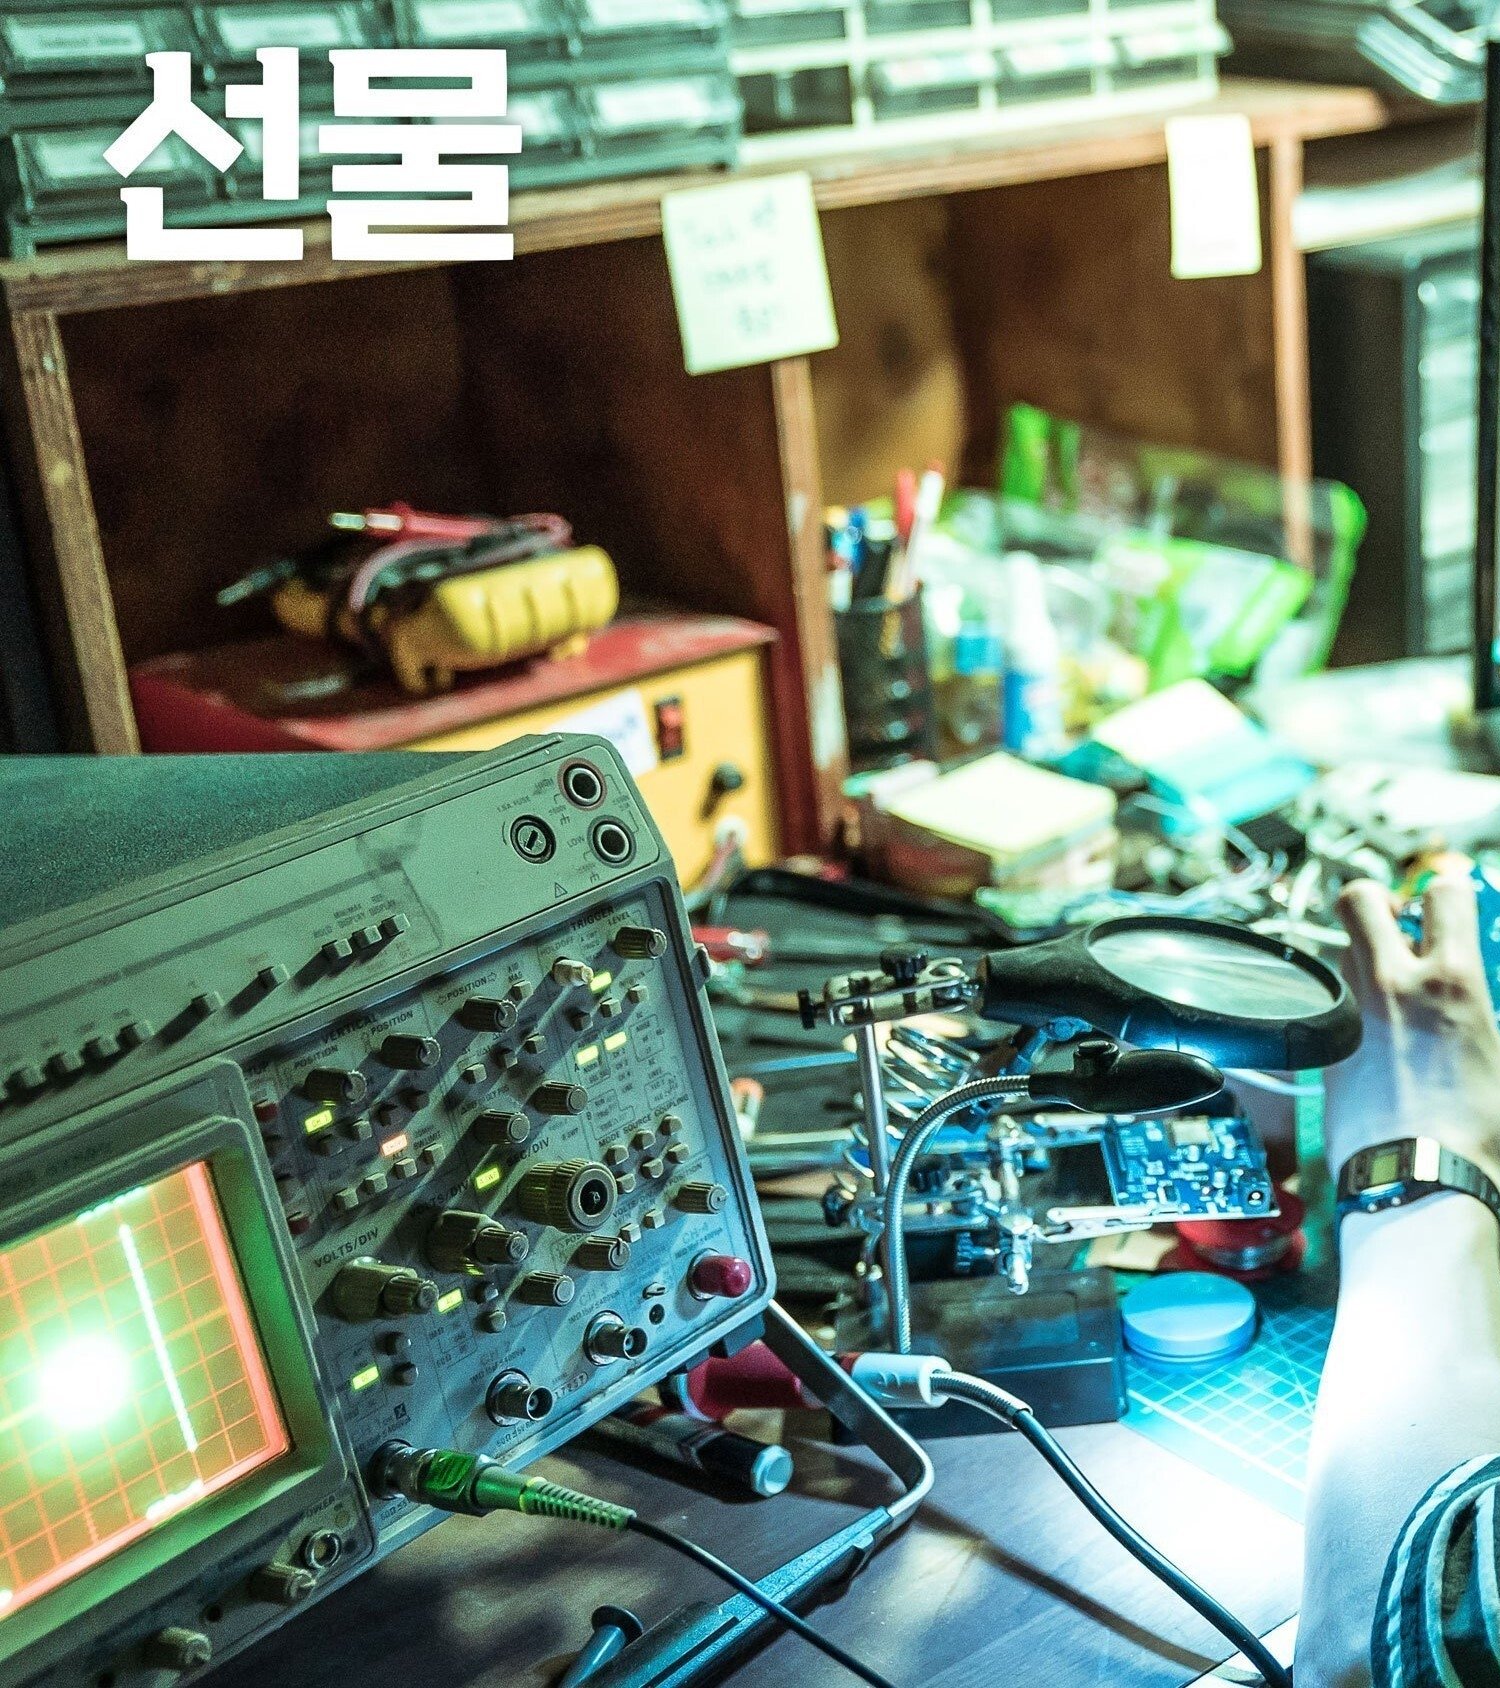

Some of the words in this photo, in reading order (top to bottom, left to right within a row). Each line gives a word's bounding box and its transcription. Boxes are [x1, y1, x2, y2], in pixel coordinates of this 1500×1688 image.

[568, 835, 584, 848] LOW
[572, 906, 612, 930] TRIGGER
[608, 910, 628, 926] LEVEL
[447, 976, 487, 1000] POSITION
[323, 1013, 376, 1044] VERTICAL
[372, 1011, 412, 1035] POSITION
[295, 1045, 337, 1070] POSITION
[598, 1130, 619, 1147] MODE
[623, 1114, 650, 1133] SOURCE
[654, 1094, 687, 1117] COUPLING
[315, 1227, 378, 1268] VOLTS/DIV
